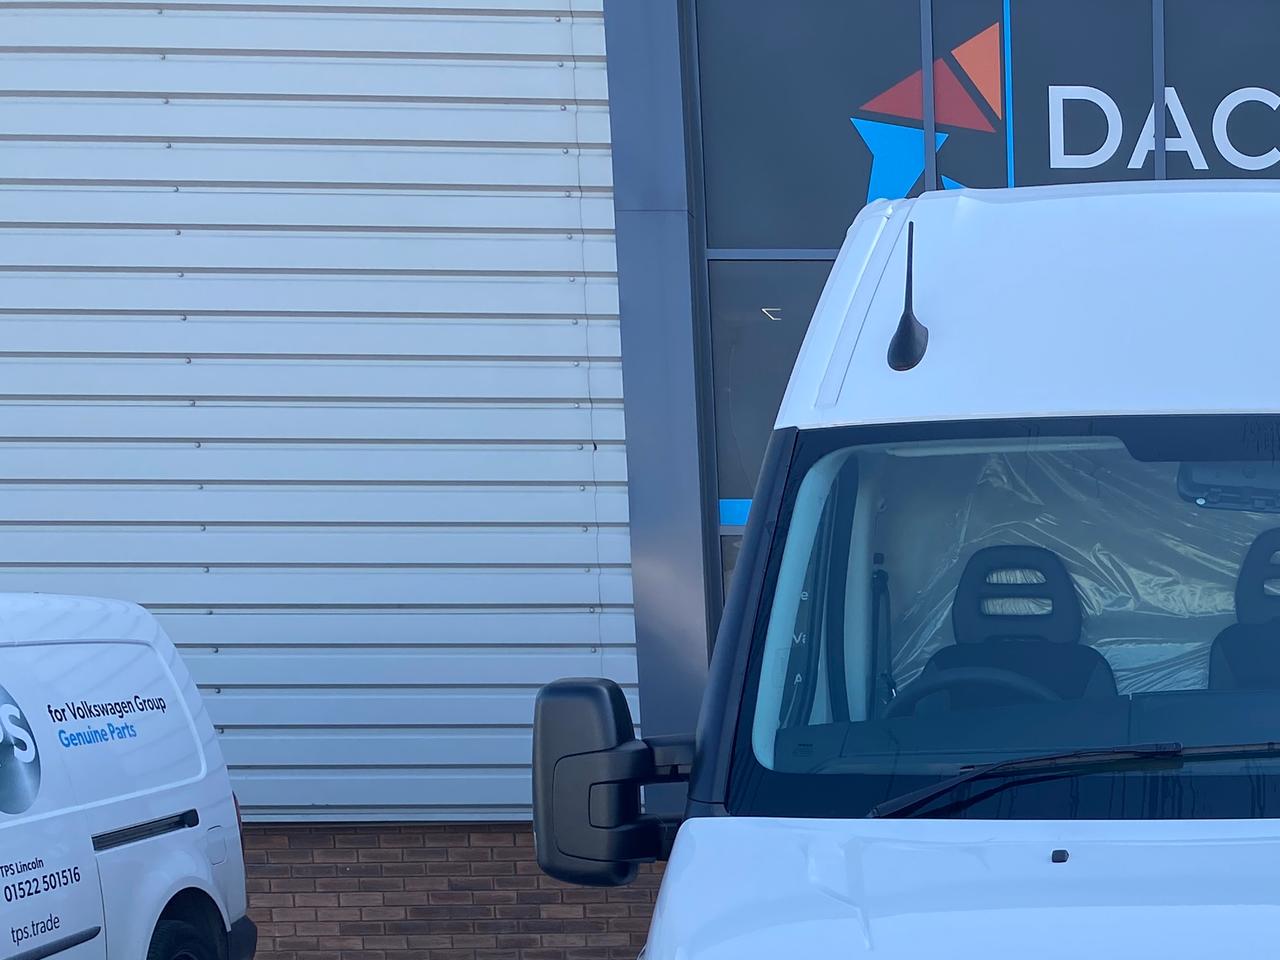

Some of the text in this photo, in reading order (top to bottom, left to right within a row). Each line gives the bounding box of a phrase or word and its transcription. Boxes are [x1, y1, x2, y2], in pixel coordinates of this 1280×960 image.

[47, 695, 167, 723] for Volkswagen Group
[58, 722, 137, 748] Genuine Parts
[0, 857, 45, 878] TPS Lincoln
[4, 866, 81, 903] 01522 501516
[11, 913, 60, 947] tps.trade
